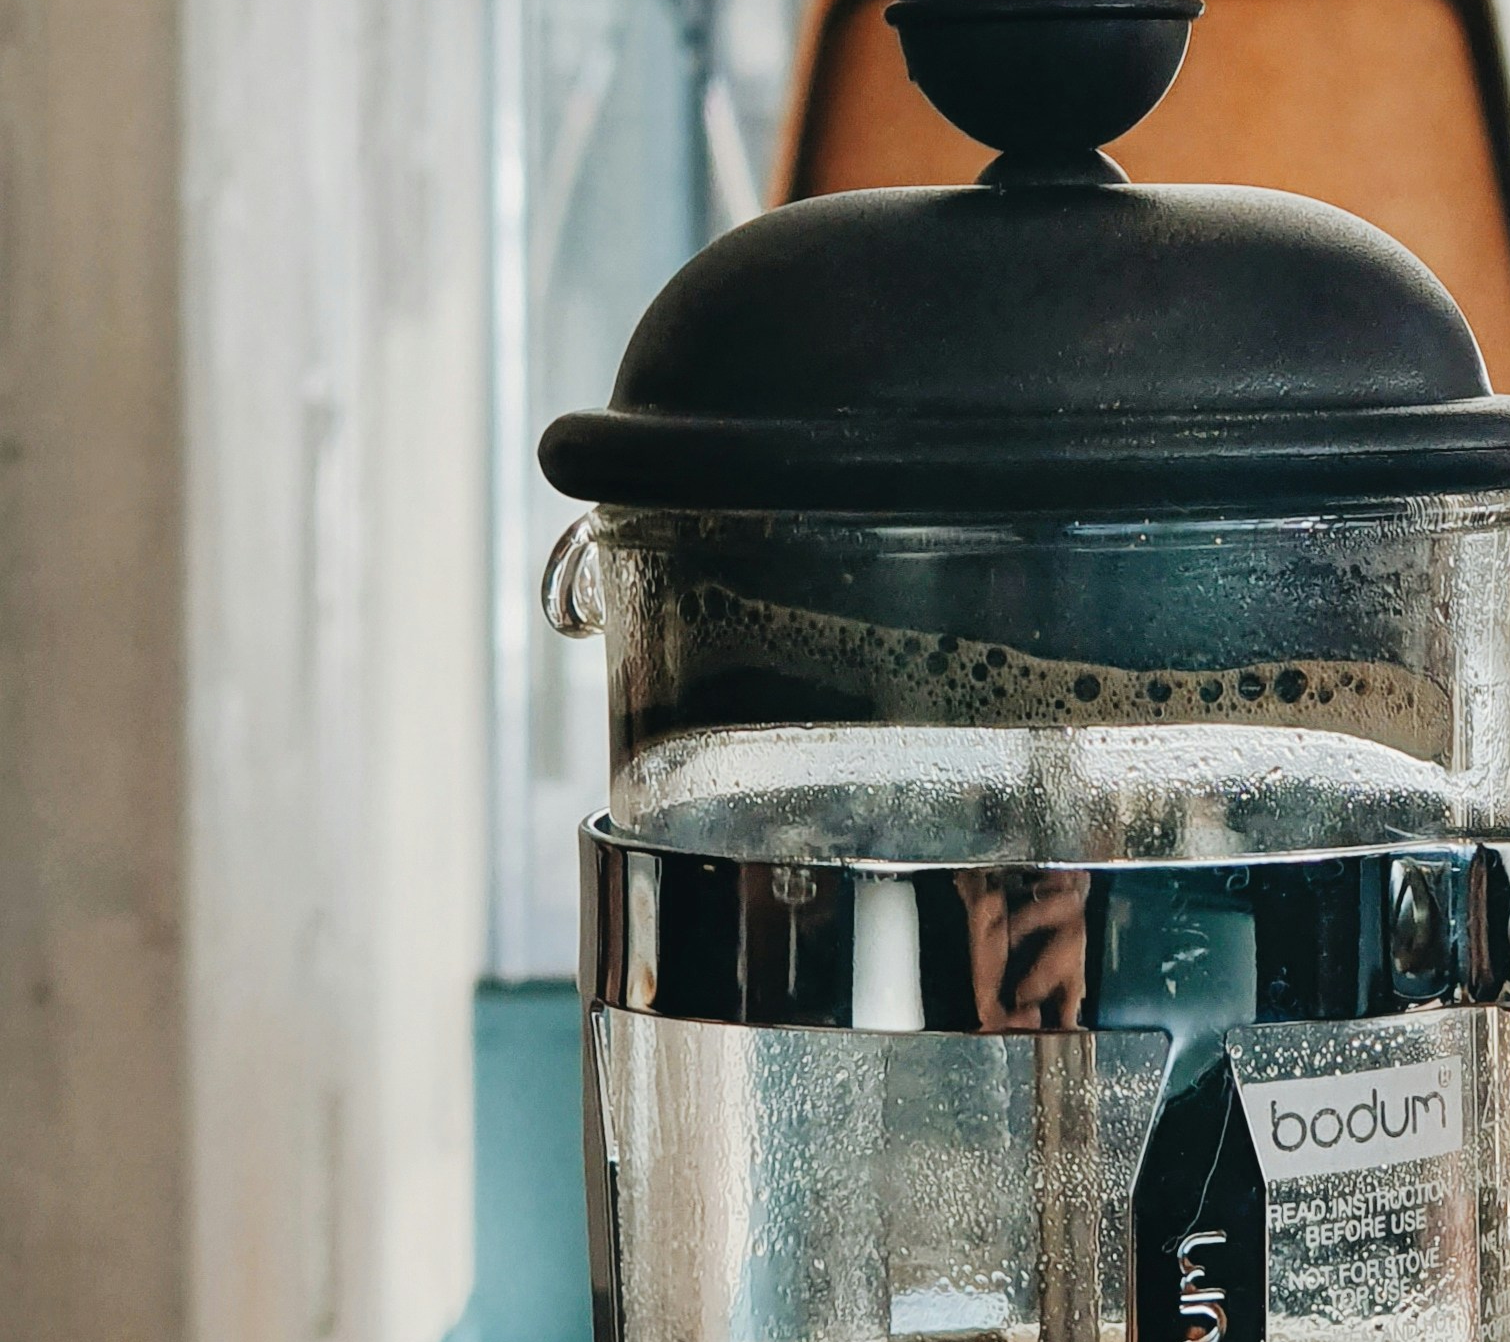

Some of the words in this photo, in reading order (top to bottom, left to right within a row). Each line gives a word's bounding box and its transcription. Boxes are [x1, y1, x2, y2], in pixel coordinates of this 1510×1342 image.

[1271, 1088, 1446, 1152] bodum
[1268, 1199, 1326, 1228] READ
[1305, 1215, 1387, 1248] BEFORE
[1391, 1208, 1428, 1235] USE
[1288, 1265, 1333, 1291] NOT
[1339, 1258, 1381, 1287] FOR
[1384, 1247, 1443, 1279] STOVE
[1330, 1285, 1369, 1311] TOP
[1374, 1277, 1412, 1304] USE
